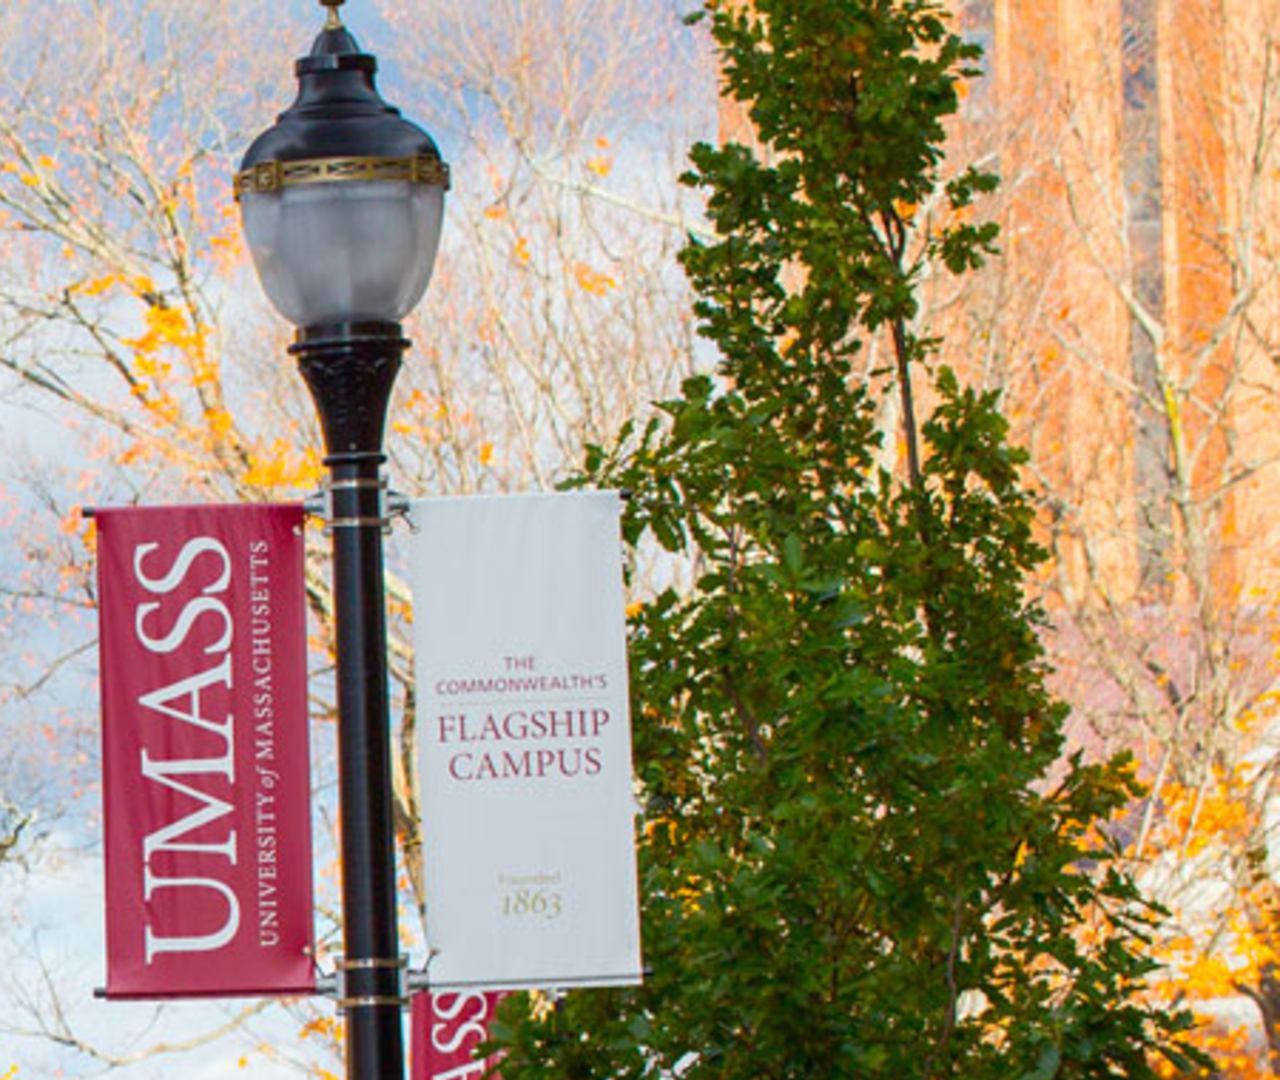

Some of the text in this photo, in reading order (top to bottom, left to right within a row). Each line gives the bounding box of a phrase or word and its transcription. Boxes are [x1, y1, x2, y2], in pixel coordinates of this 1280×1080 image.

[503, 656, 535, 671] THE
[435, 674, 608, 695] COMMONWEALTH'S
[438, 708, 610, 743] FLAGSHIP
[133, 537, 240, 964] UMASS
[249, 540, 279, 947] UNIVERSITY of MASSACHUSETTS
[448, 748, 602, 781] CAMPUS
[502, 888, 562, 920] 1863
